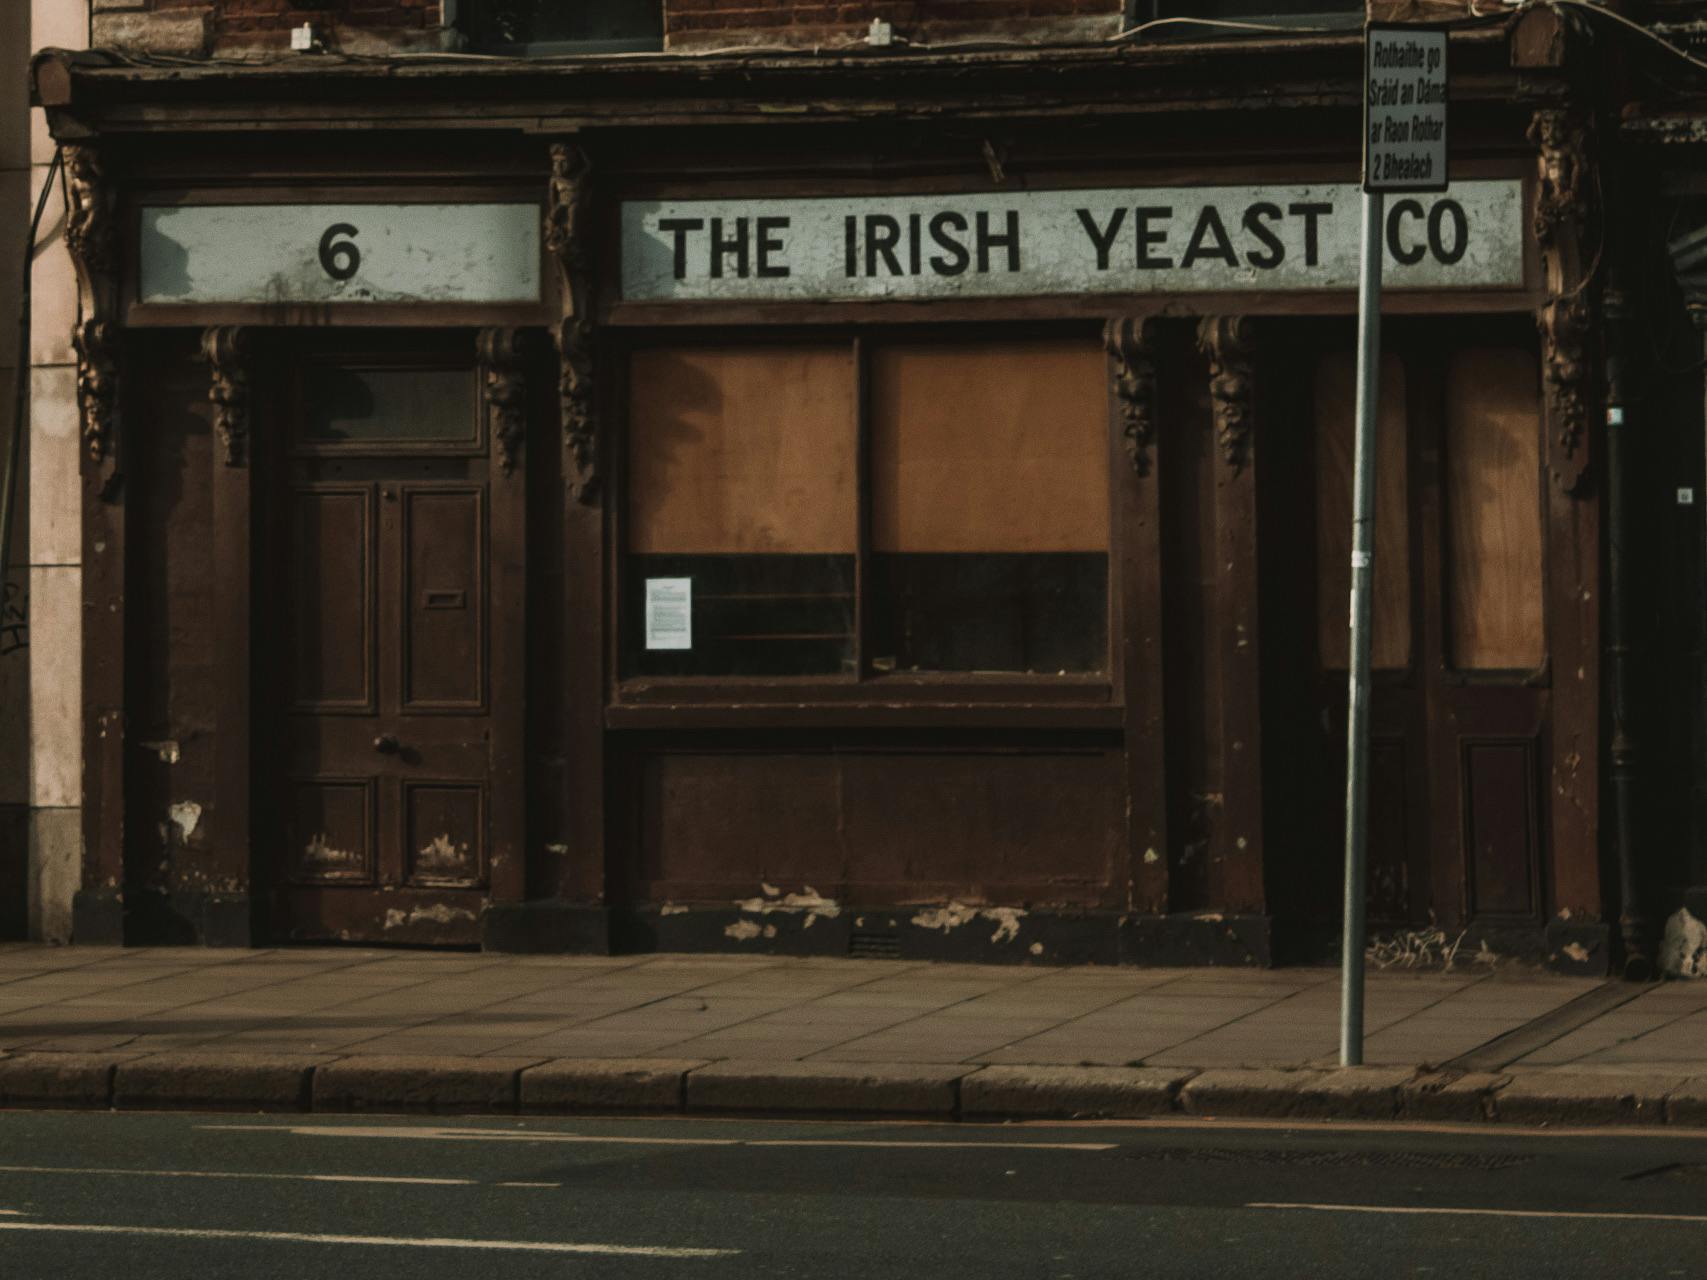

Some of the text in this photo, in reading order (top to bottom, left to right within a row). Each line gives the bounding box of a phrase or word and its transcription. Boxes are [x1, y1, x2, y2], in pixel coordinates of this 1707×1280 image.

[1374, 41, 1440, 74] Rothaithe go
[1401, 83, 1414, 105] an
[1371, 114, 1443, 144] ar Raon Rothar
[1373, 152, 1432, 180] 2 Bhealach
[318, 223, 360, 280] 6
[658, 198, 1469, 280] THE IRISH YEAST CO
